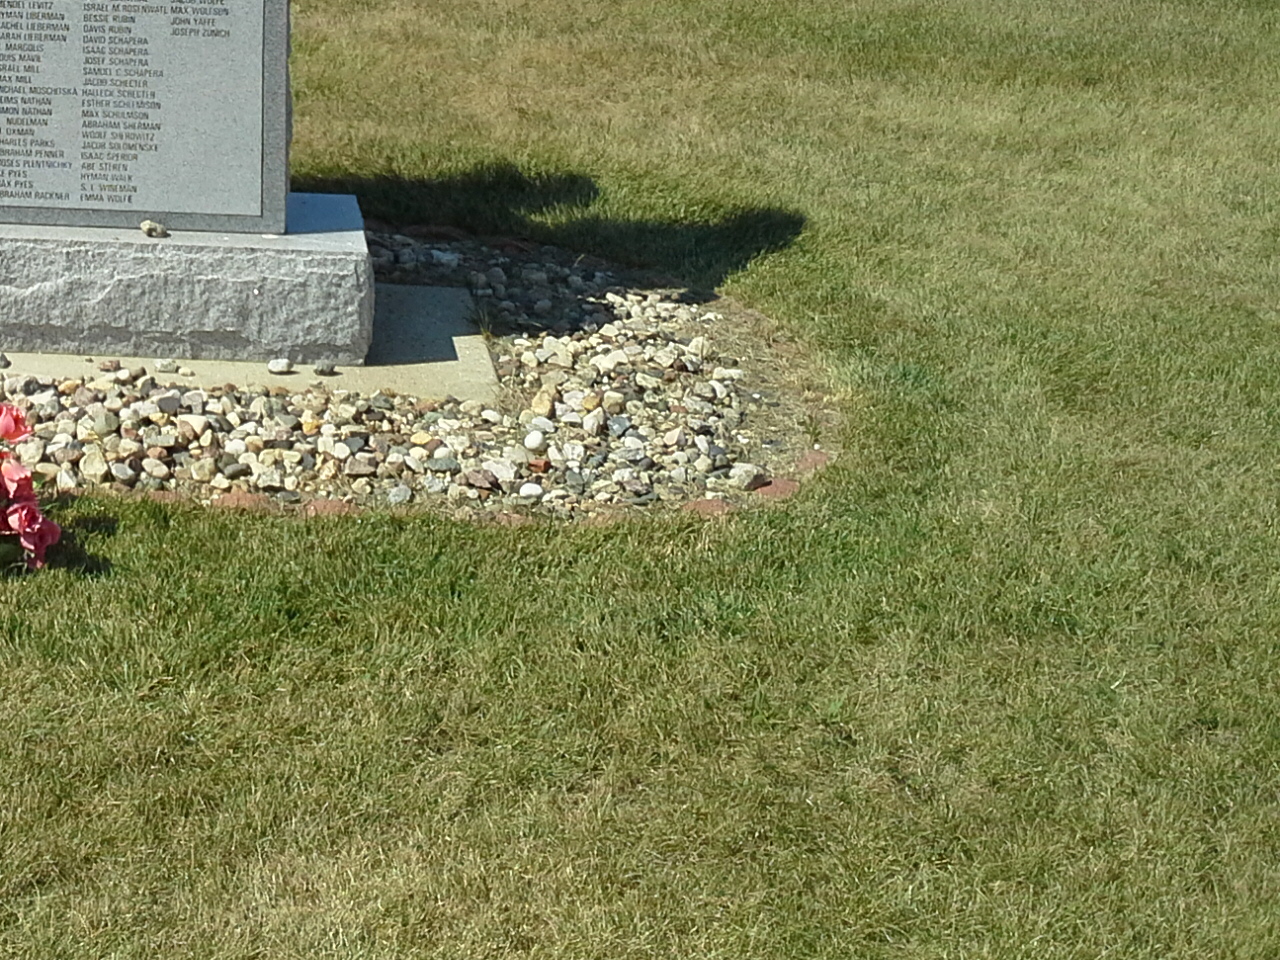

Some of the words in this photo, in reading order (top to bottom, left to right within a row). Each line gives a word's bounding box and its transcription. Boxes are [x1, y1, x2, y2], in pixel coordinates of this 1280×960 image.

[83, 36, 105, 44] DAVID
[21, 97, 51, 105] NATHAN
[22, 108, 52, 116] NATHAN
[82, 110, 99, 118] MAX
[82, 120, 120, 129] ABRAHAM
